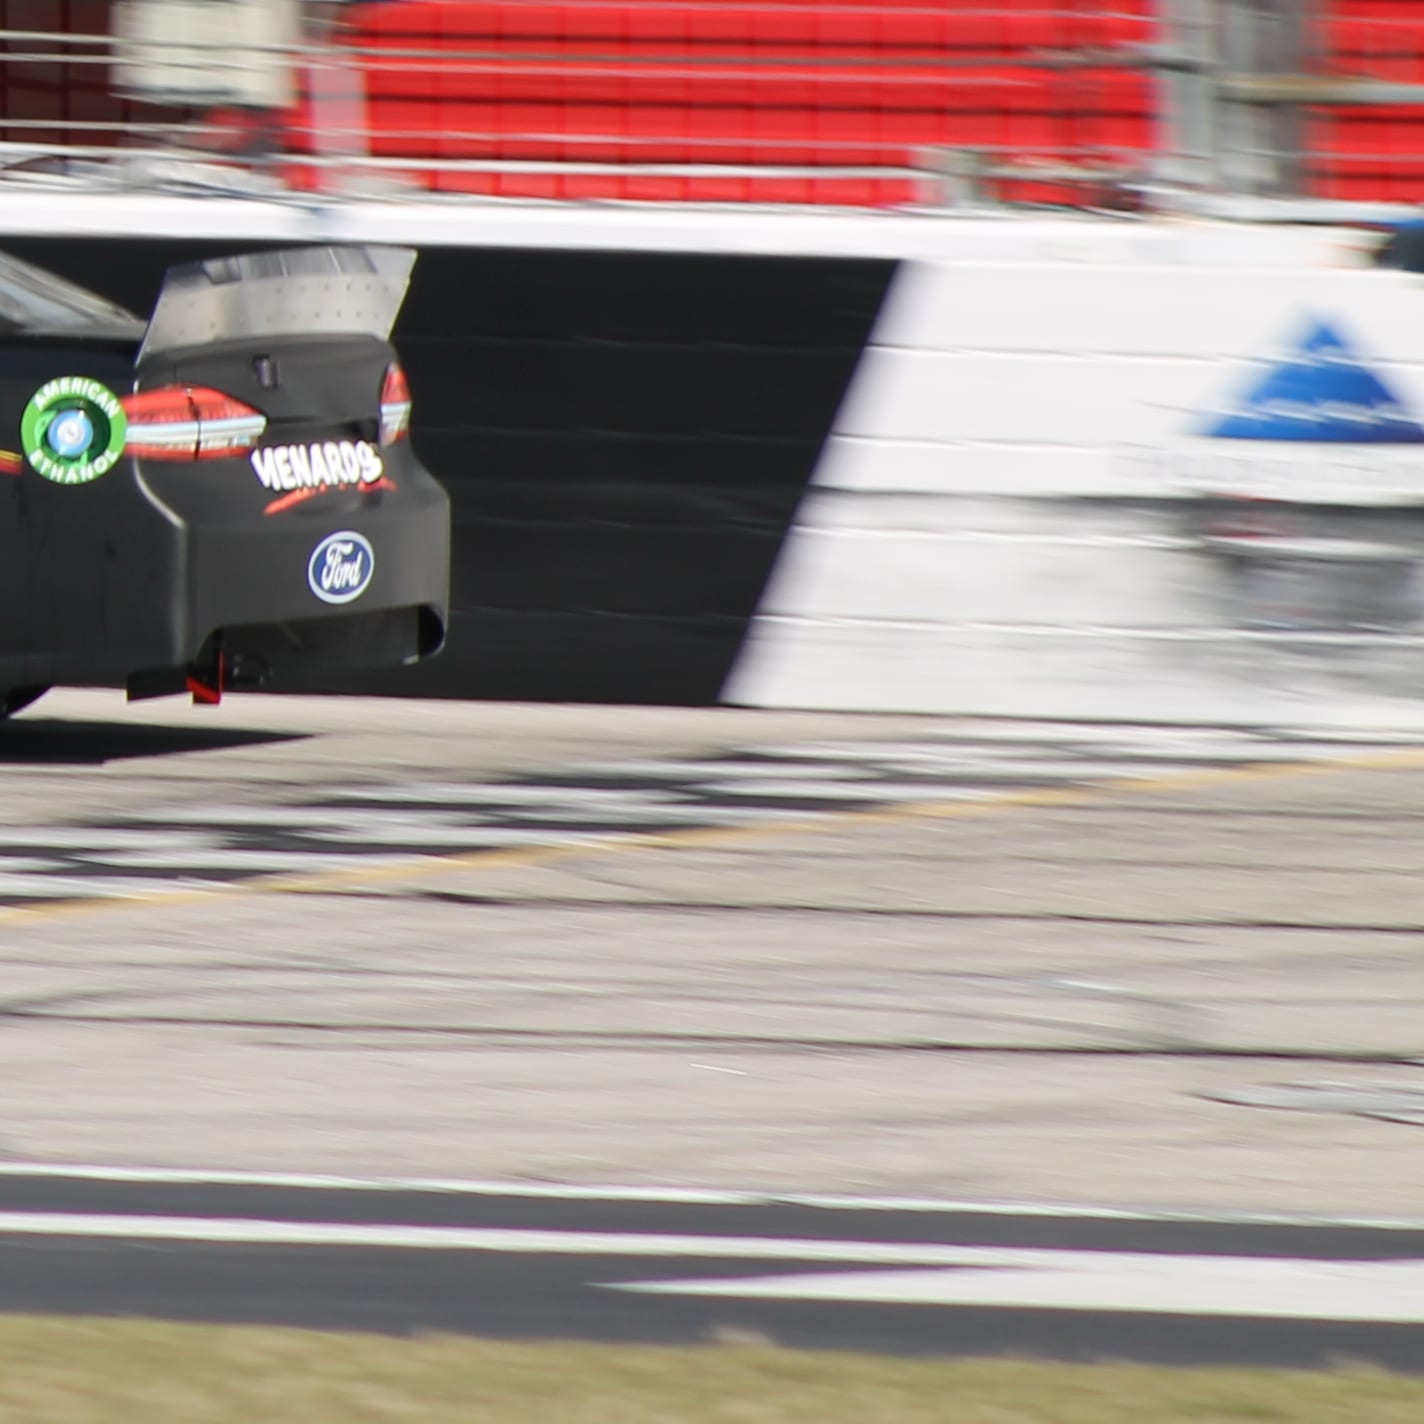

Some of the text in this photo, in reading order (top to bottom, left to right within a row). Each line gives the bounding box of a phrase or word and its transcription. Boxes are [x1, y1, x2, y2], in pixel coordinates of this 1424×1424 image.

[32, 376, 122, 419] AMERICAN
[28, 448, 120, 484] ETHANOL
[250, 439, 384, 492] MENARDS
[320, 540, 365, 591] Ford
